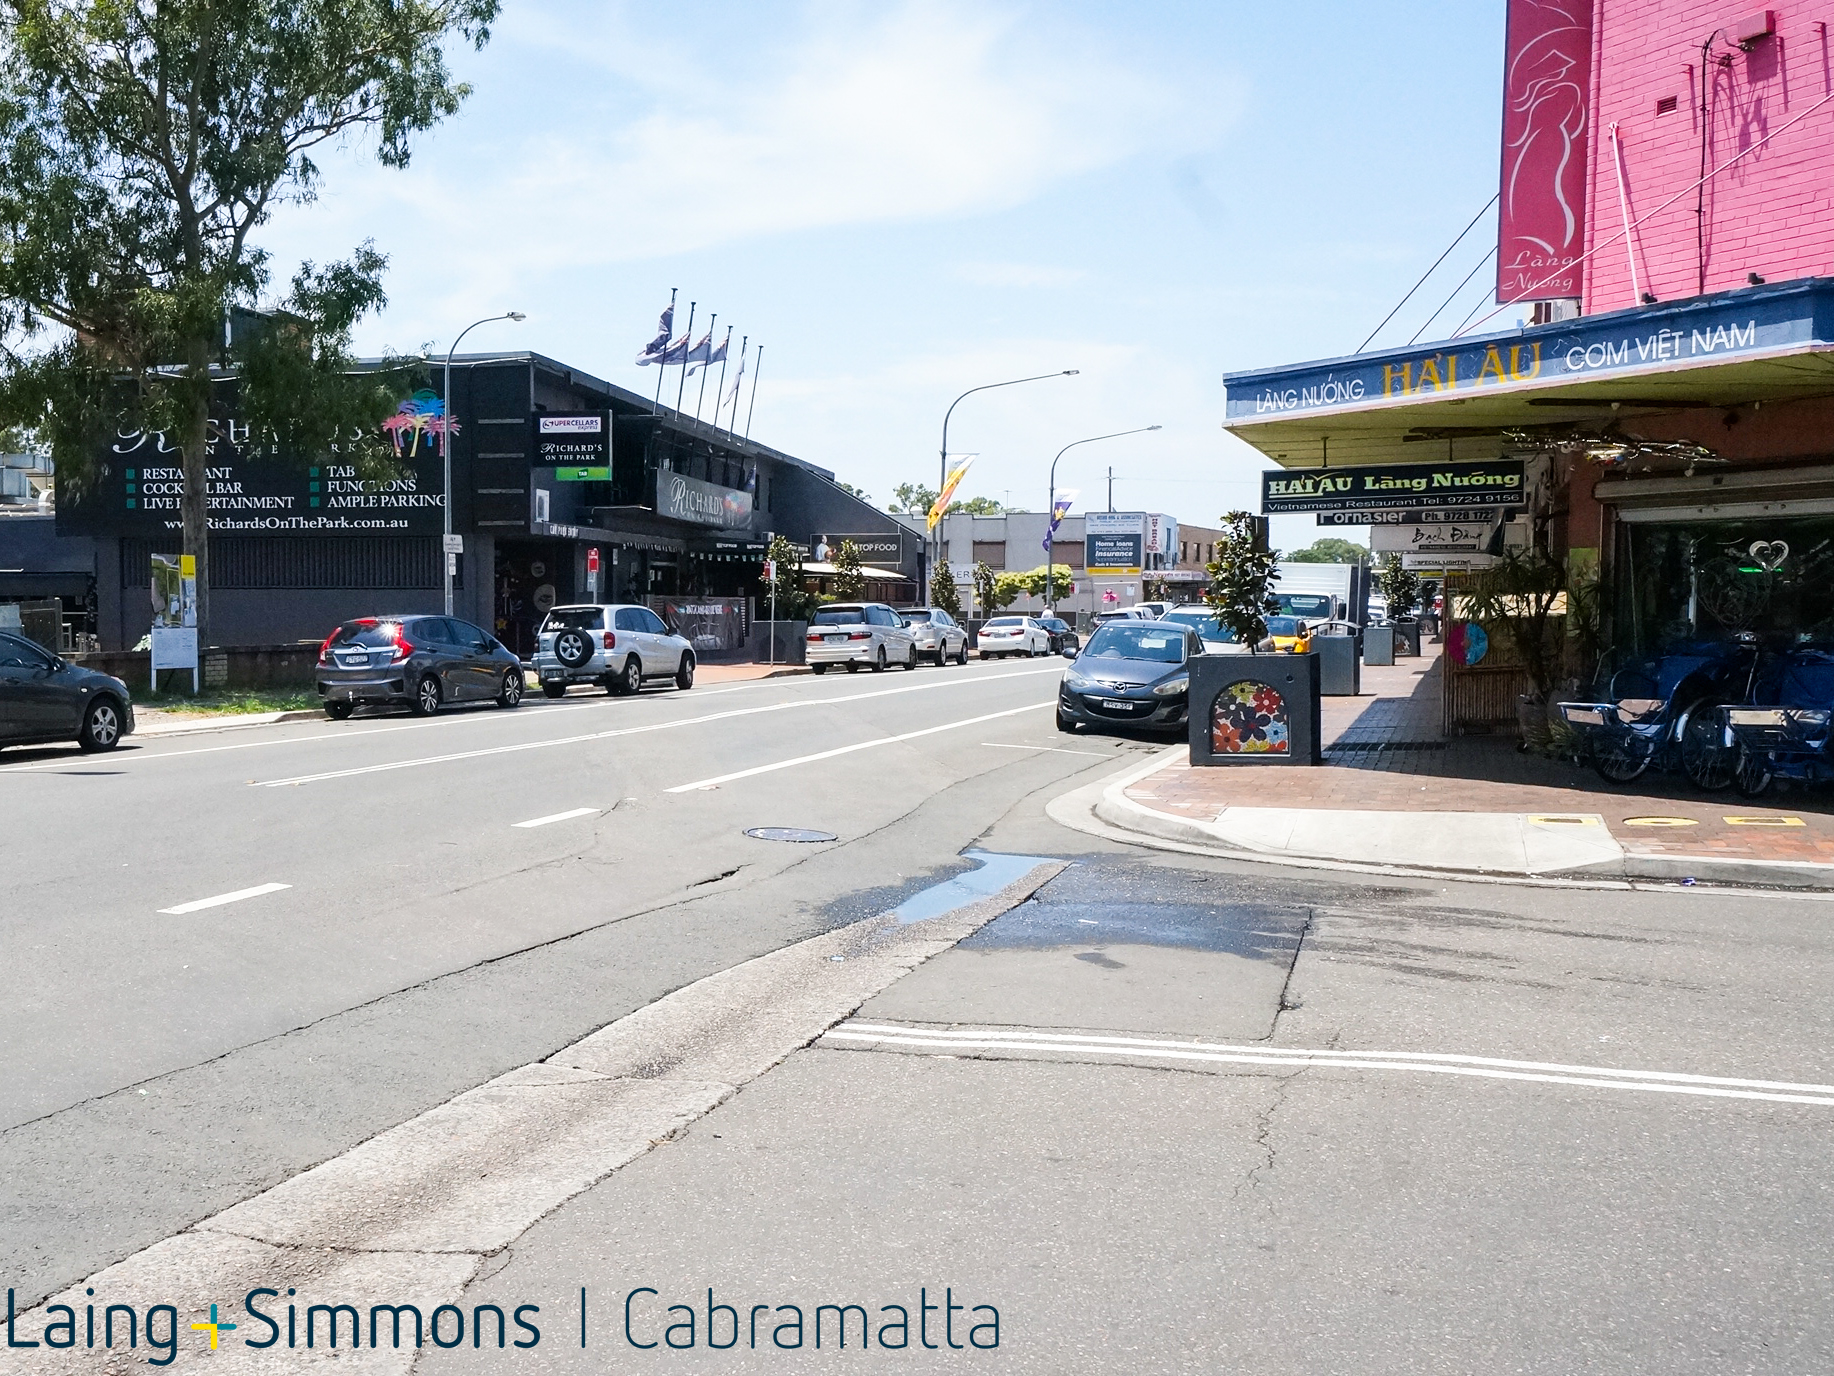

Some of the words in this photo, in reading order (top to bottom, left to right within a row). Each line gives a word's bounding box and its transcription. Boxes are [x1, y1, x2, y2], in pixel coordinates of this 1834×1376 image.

[1634, 328, 1684, 367] VIỆT
[1691, 320, 1756, 354] NAM
[541, 443, 603, 453] RICHARD'S
[142, 467, 232, 480] RESTAANT
[326, 465, 356, 477] TAB
[142, 482, 213, 495] COCKL
[217, 482, 244, 494] BAR
[143, 499, 173, 509] LIVE
[327, 497, 378, 507] AMPLE
[1268, 502, 1342, 511] Vietnamese
[1345, 498, 1417, 508] Restaurant
[1420, 497, 1443, 505] Tel:
[1447, 495, 1481, 504] 9724
[1485, 493, 1520, 502] 9156
[1444, 512, 1470, 521] 9728
[875, 543, 898, 551] FOOD
